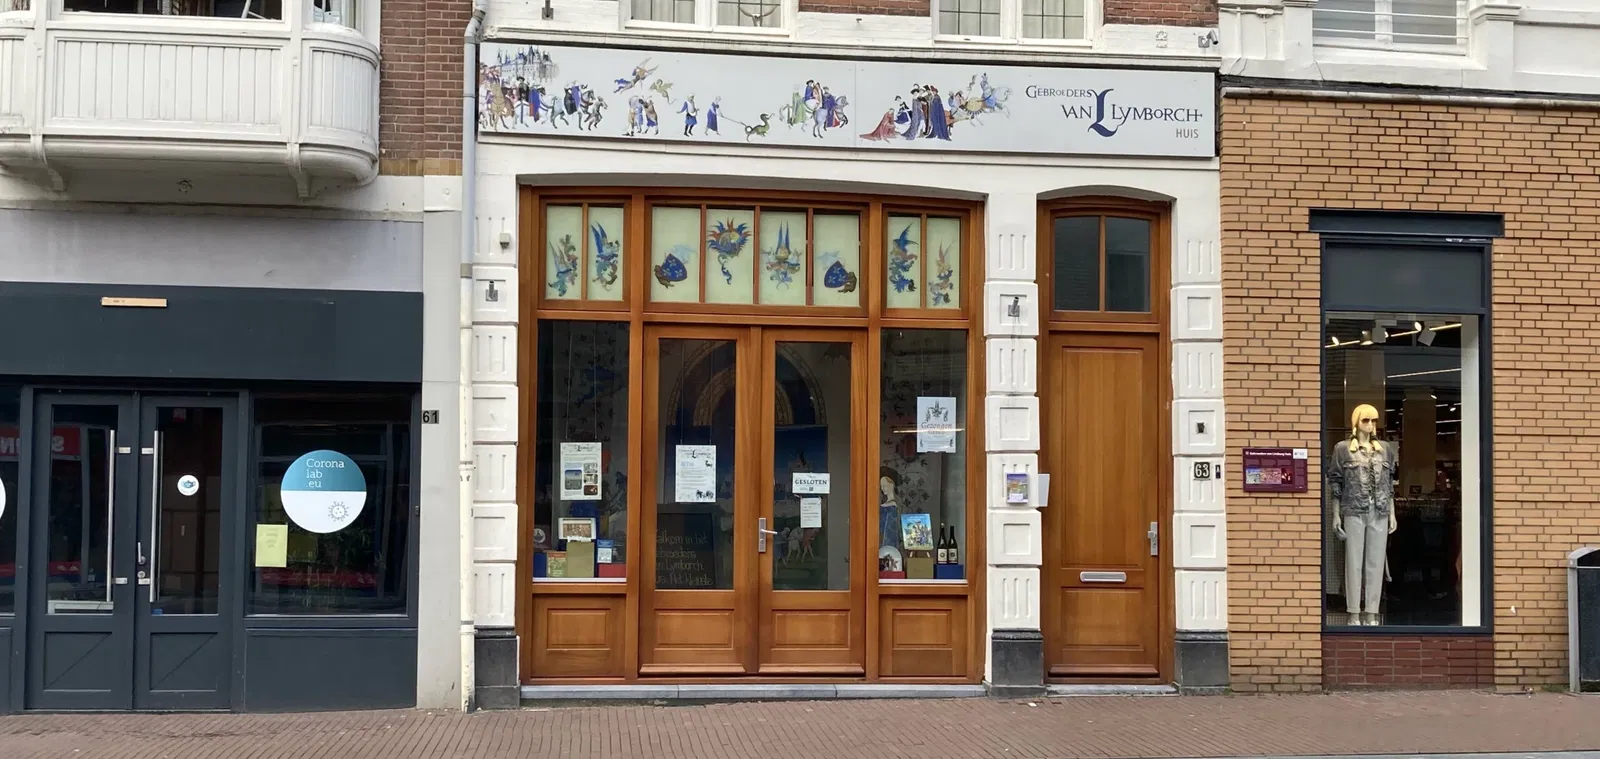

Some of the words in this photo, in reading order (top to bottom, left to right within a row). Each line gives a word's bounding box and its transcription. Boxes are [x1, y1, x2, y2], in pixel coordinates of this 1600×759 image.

[1025, 85, 1093, 99] GEBROEDERS
[1061, 104, 1092, 119] VAN
[1175, 128, 1200, 139] HUIS
[422, 410, 438, 424] 61
[305, 458, 346, 469] Corona
[306, 469, 323, 479] lab
[1195, 463, 1209, 477] 63
[305, 479, 322, 488] .eu
